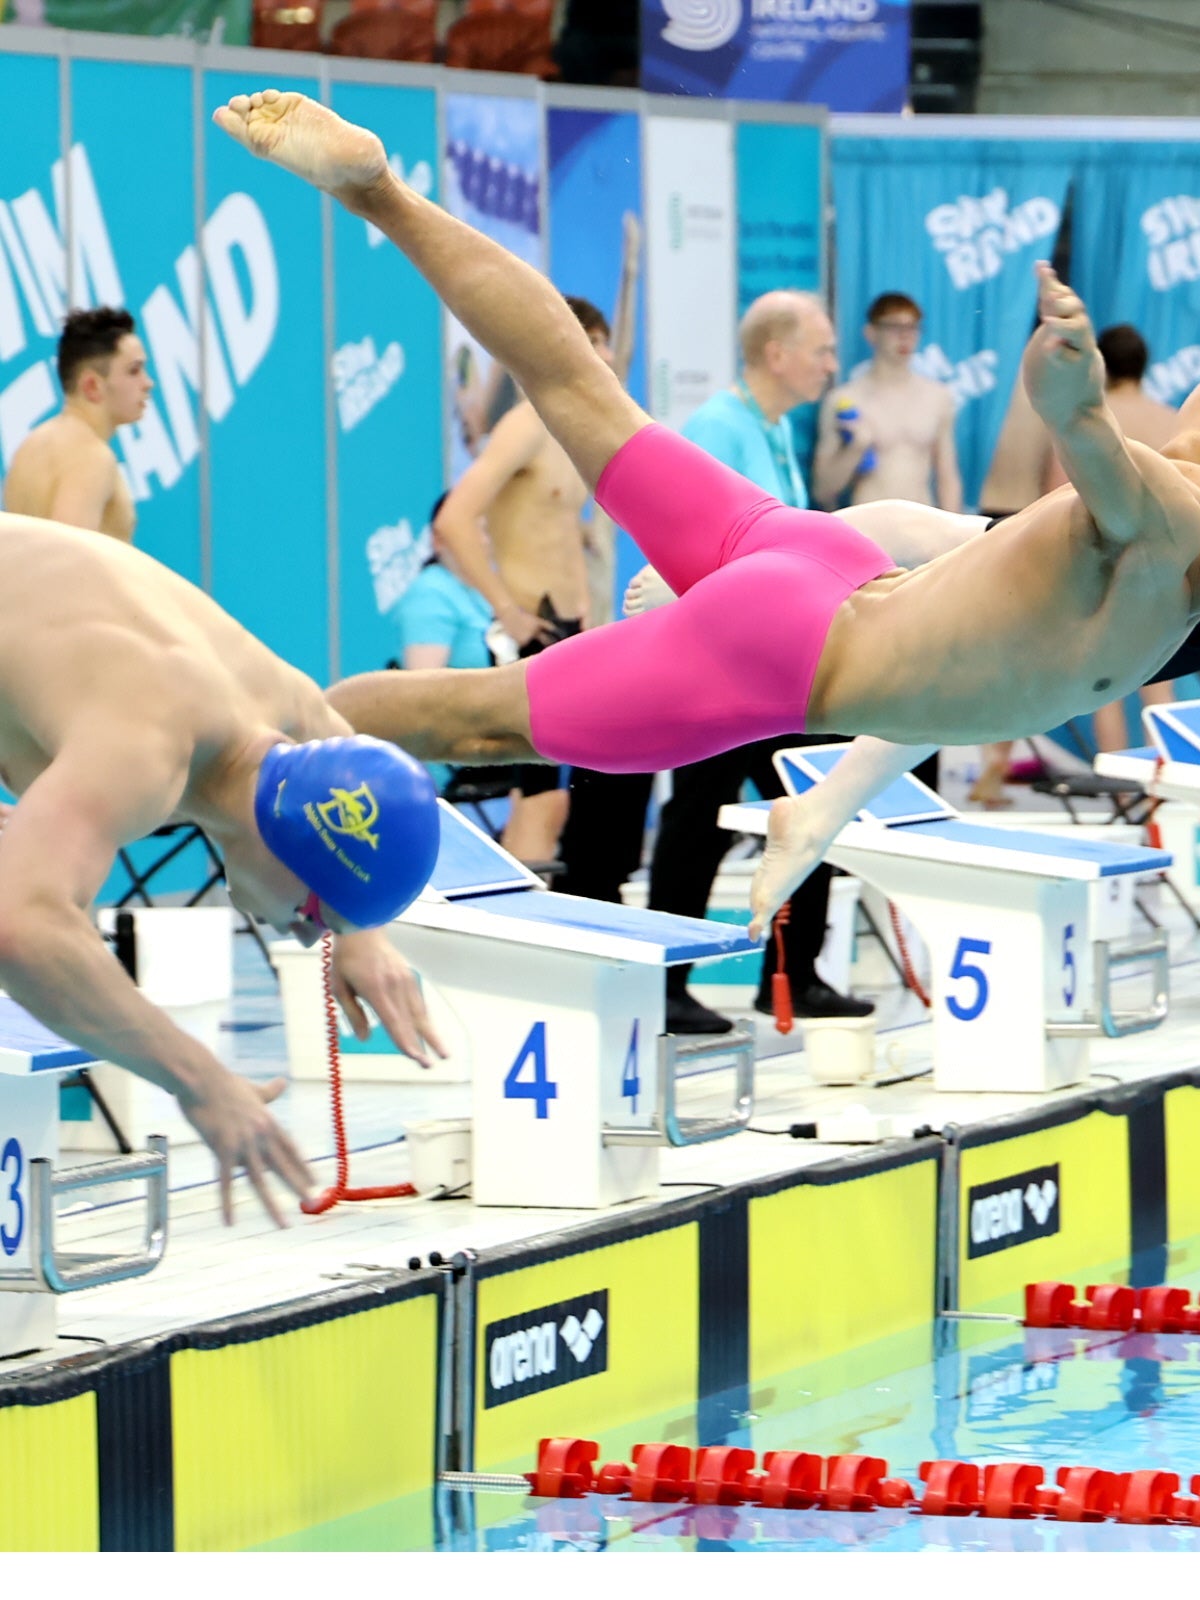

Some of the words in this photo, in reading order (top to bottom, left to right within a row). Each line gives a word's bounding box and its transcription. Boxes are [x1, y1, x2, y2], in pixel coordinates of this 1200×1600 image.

[945, 936, 992, 1022] 5
[1062, 924, 1077, 1008] 5
[503, 1021, 557, 1120] 4
[622, 1017, 641, 1116] 4
[0, 1137, 24, 1257] 3
[489, 1320, 557, 1391] arena
